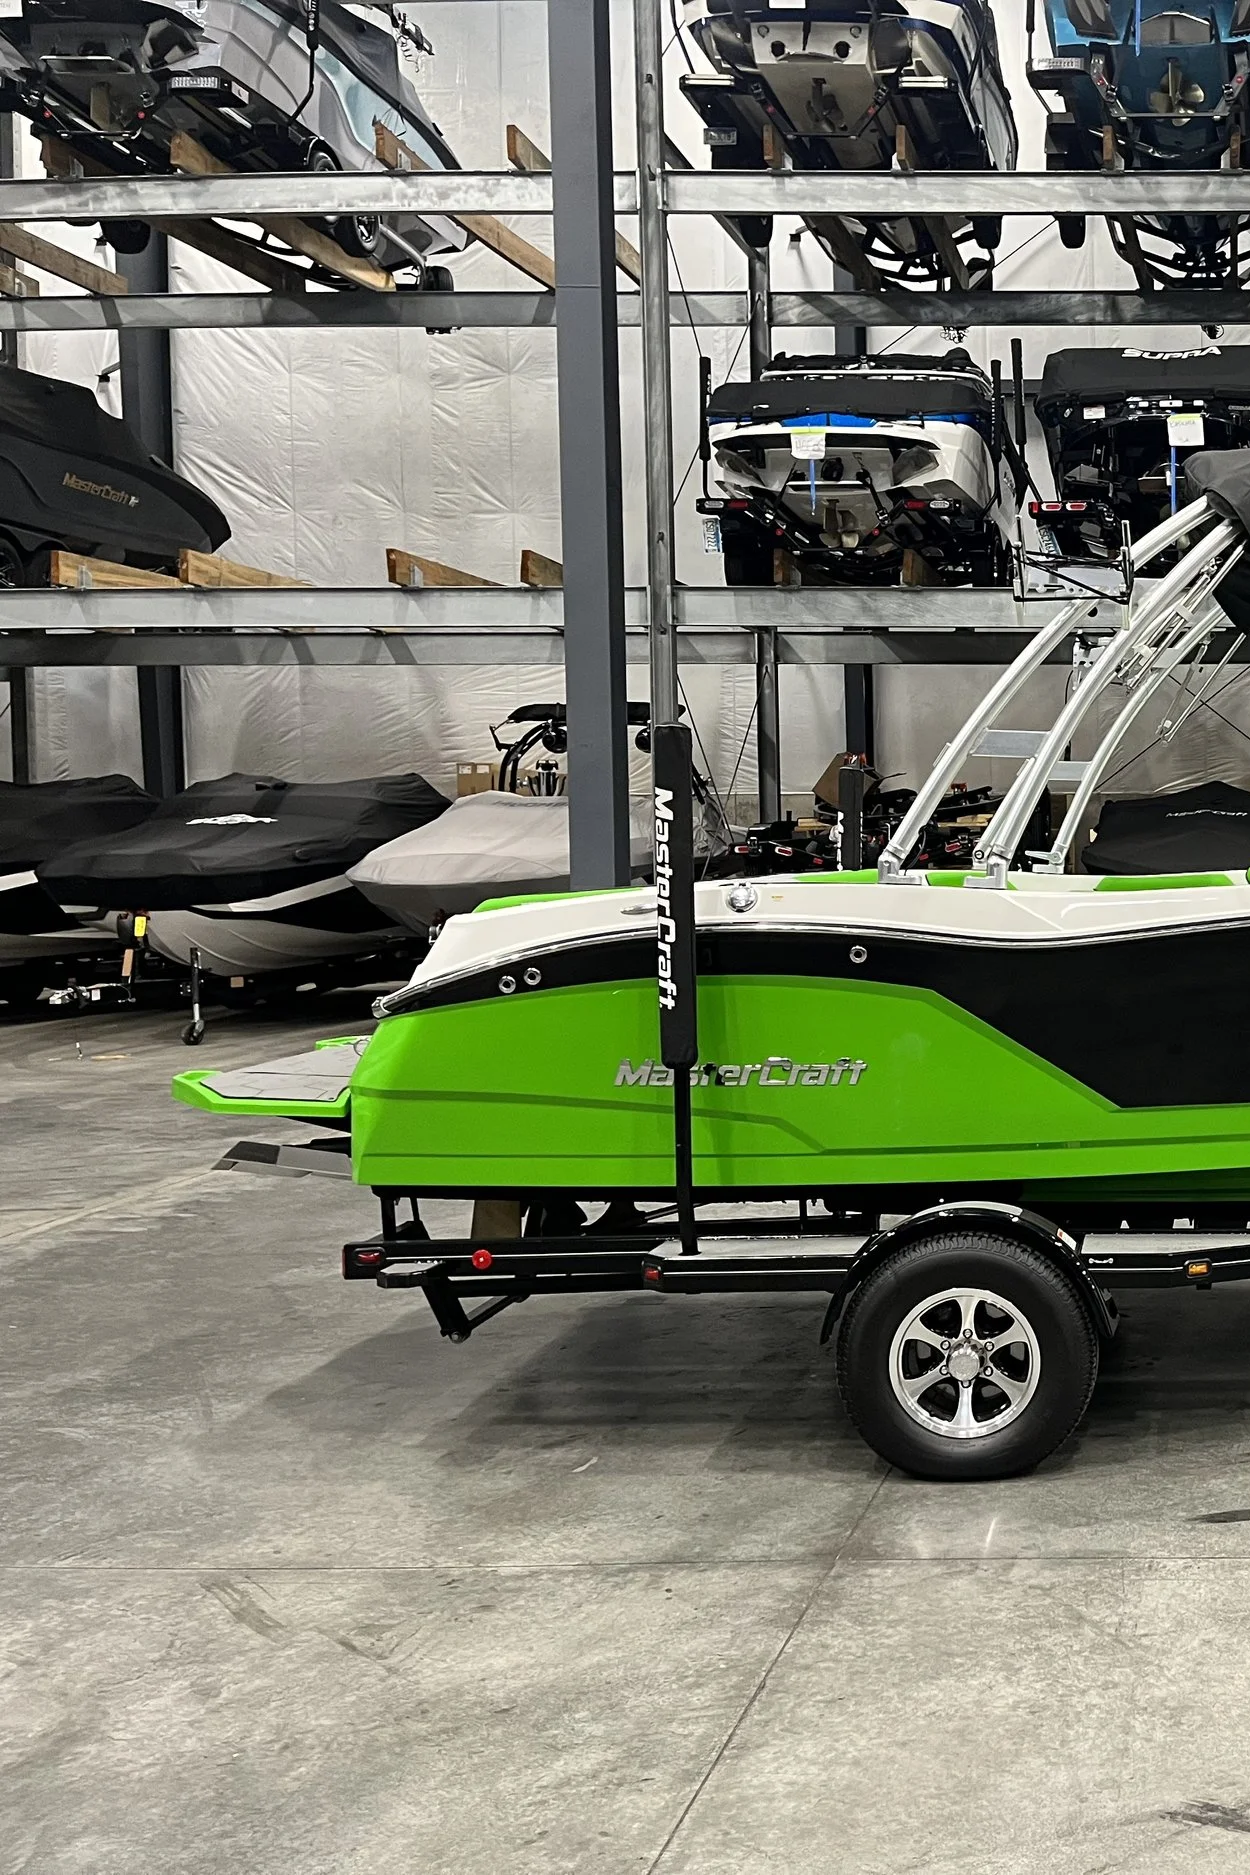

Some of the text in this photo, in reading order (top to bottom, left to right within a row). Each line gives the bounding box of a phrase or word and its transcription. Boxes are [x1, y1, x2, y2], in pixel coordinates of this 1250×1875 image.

[1121, 346, 1222, 360] SUPRA
[62, 471, 129, 505] MasterCraft
[654, 786, 677, 1010] MasterCraft
